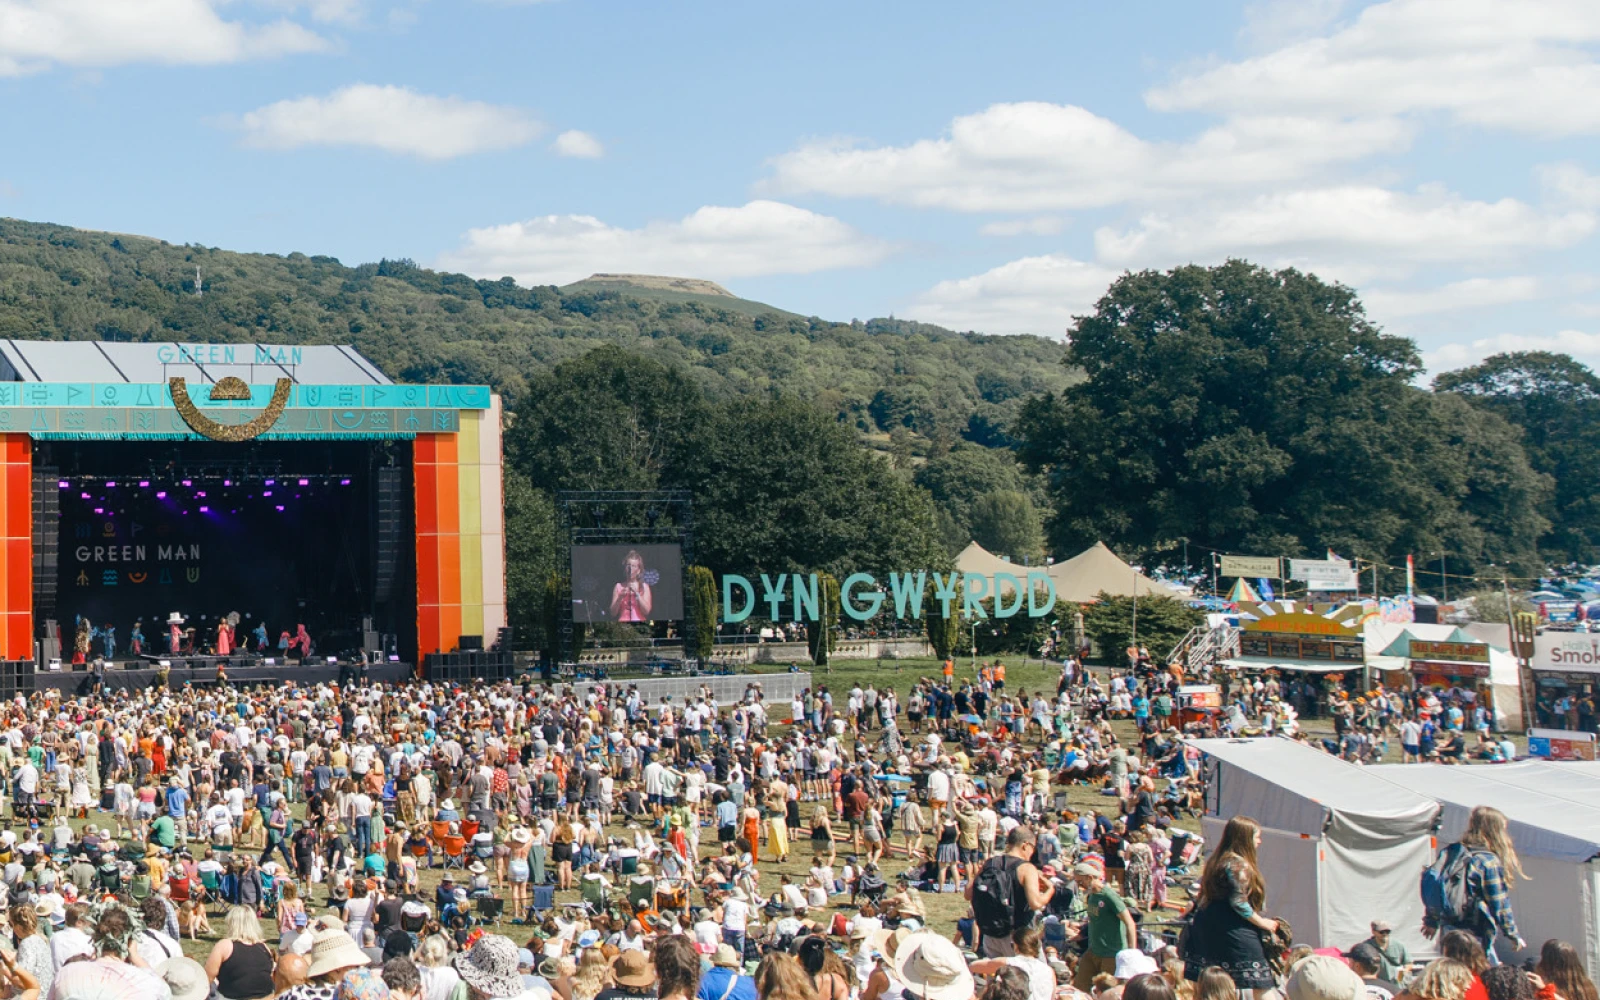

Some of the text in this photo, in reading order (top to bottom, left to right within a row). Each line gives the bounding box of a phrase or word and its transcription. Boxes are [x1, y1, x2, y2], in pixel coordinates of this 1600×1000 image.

[157, 345, 302, 365] GREEN MAN
[76, 544, 200, 562] GREEN MAN
[722, 572, 1057, 623] DYN GWYRDD
